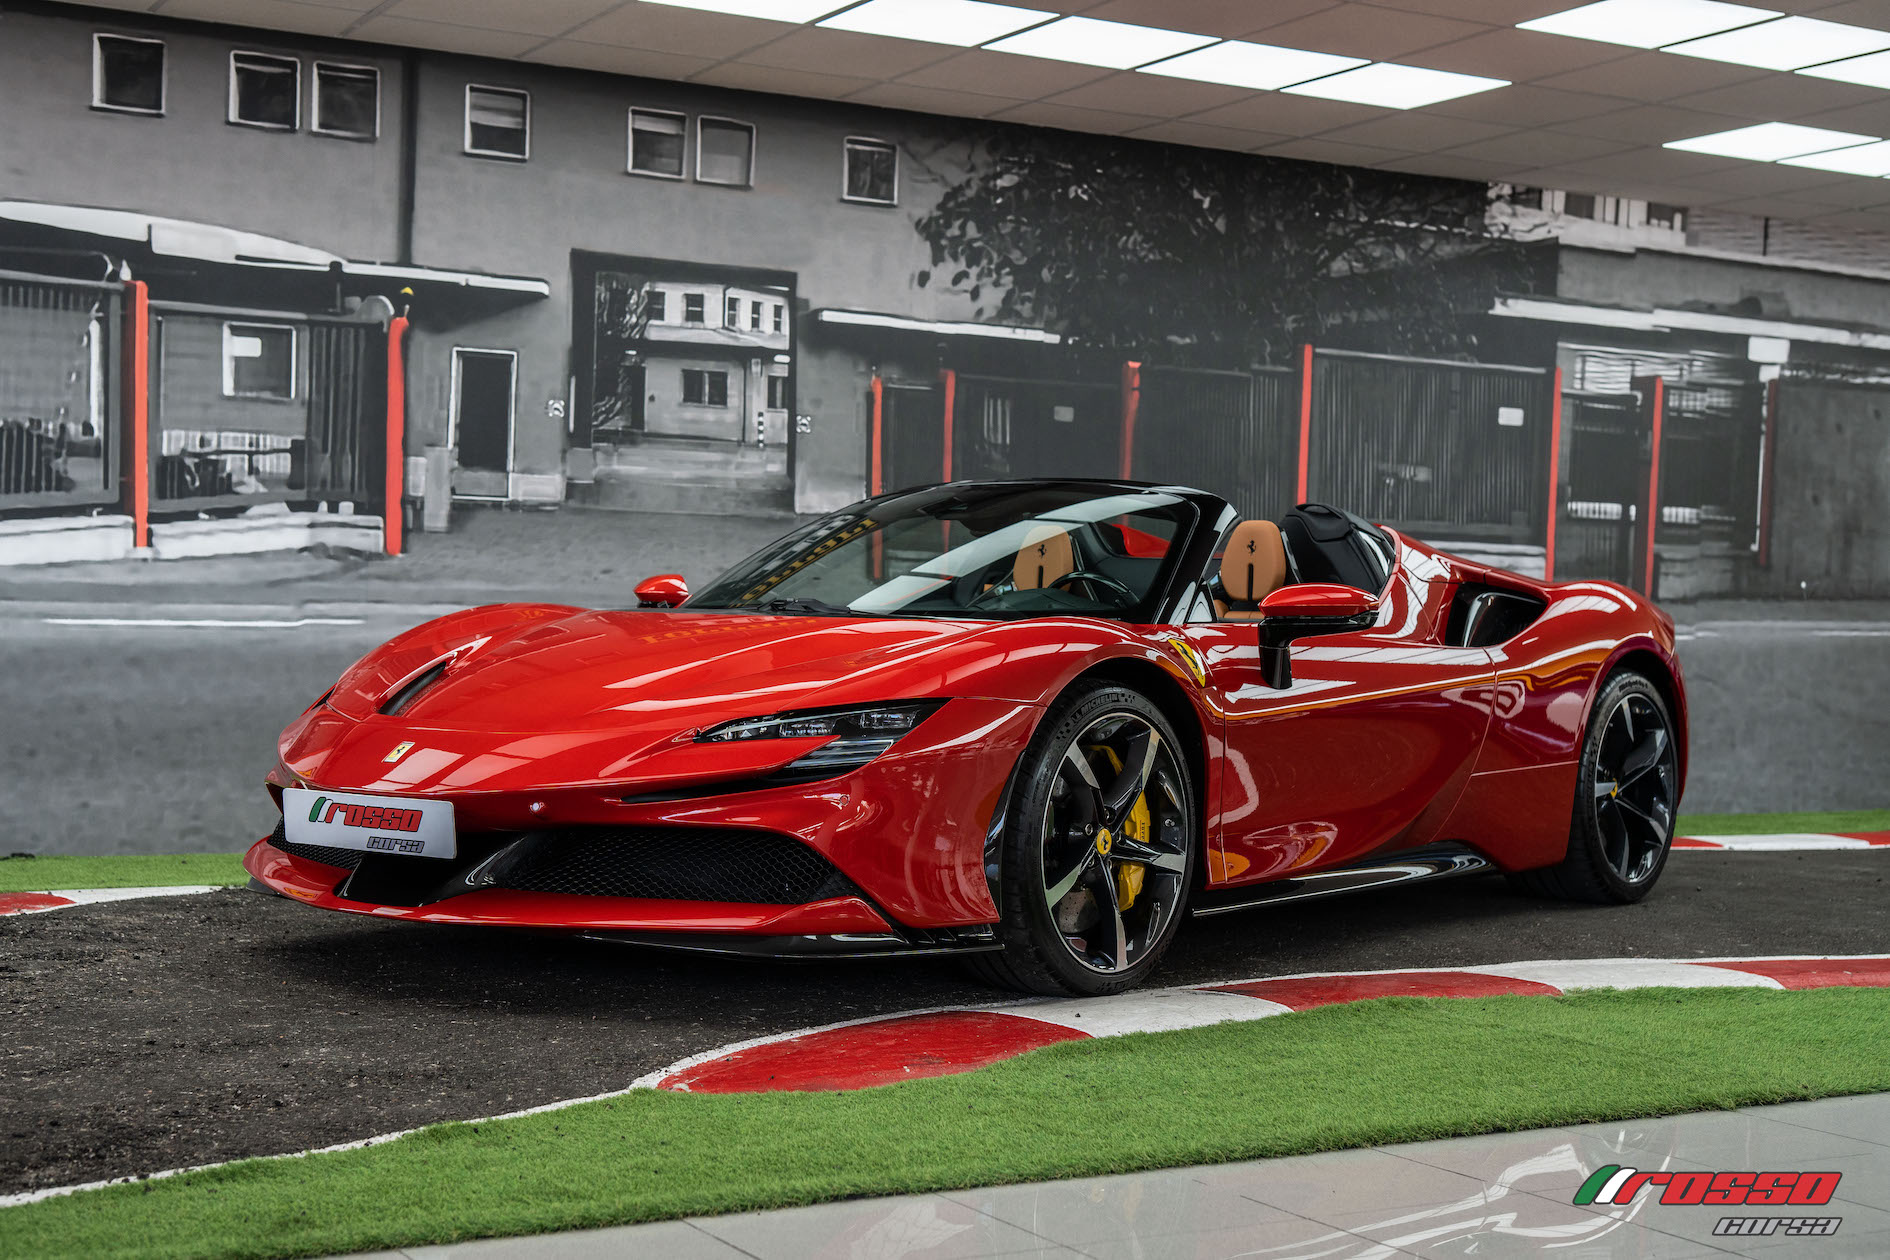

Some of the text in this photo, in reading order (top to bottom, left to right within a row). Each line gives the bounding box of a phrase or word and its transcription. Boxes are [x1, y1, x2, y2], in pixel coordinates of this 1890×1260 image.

[1081, 693, 1119, 716] MICHELIN
[325, 803, 423, 832] rosso
[366, 836, 425, 853] corsa
